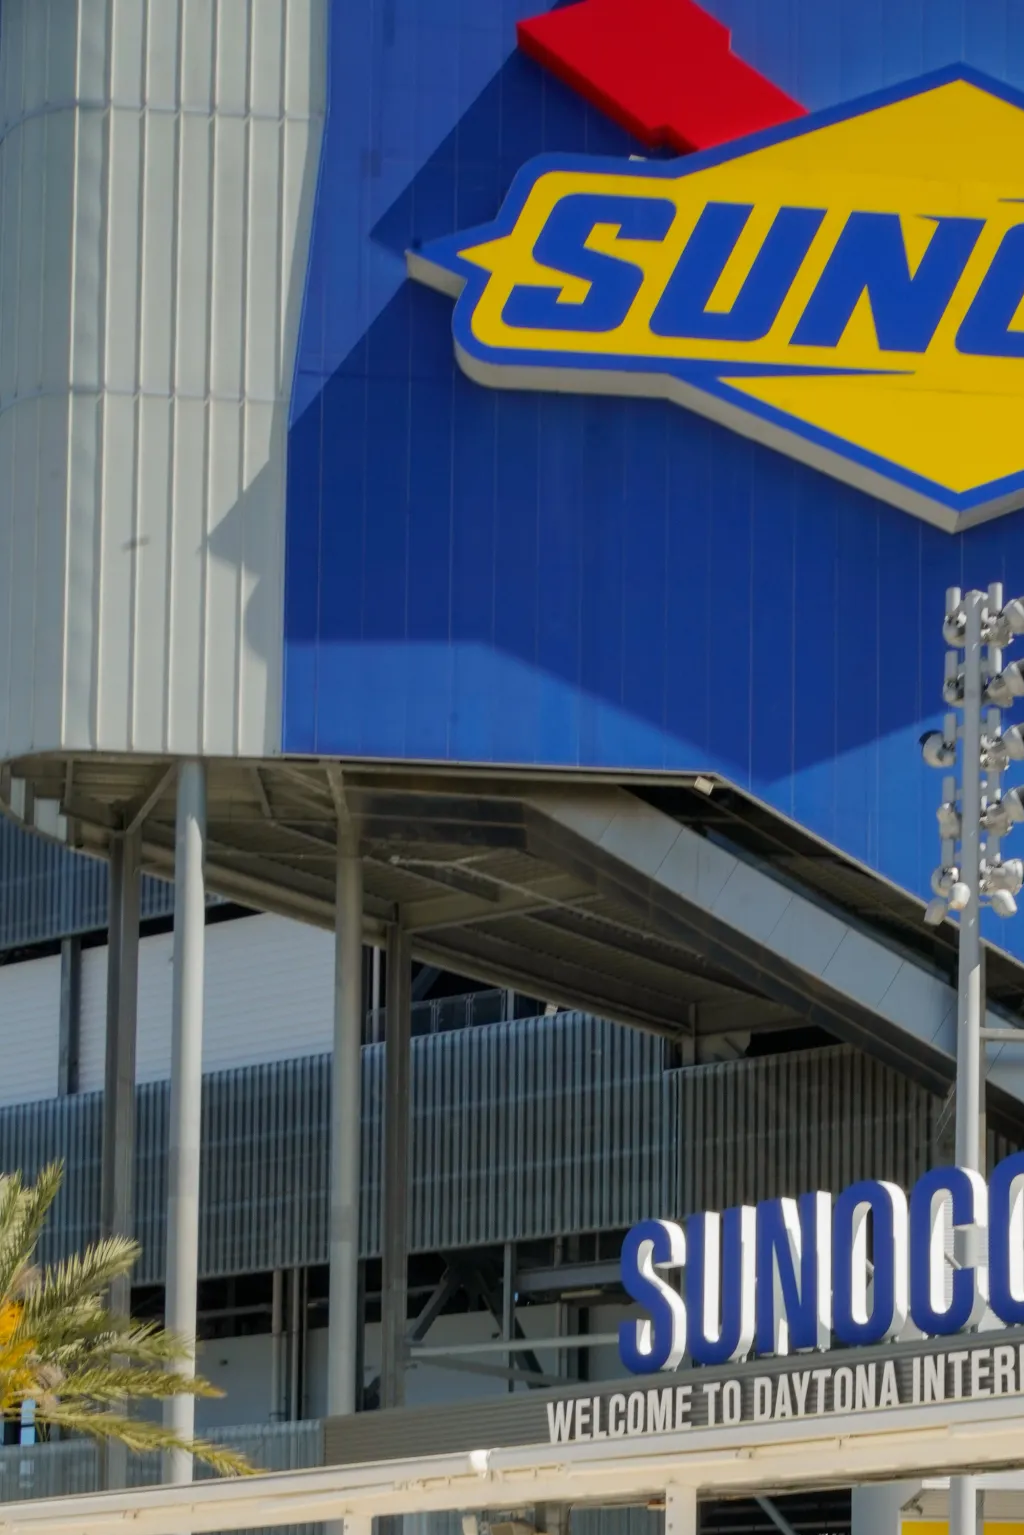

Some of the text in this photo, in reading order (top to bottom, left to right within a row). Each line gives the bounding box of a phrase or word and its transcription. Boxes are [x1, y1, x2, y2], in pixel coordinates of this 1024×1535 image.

[546, 1385, 693, 1444] WELCOME
[702, 1379, 742, 1426] TO
[754, 1360, 900, 1420] DAYTONA
